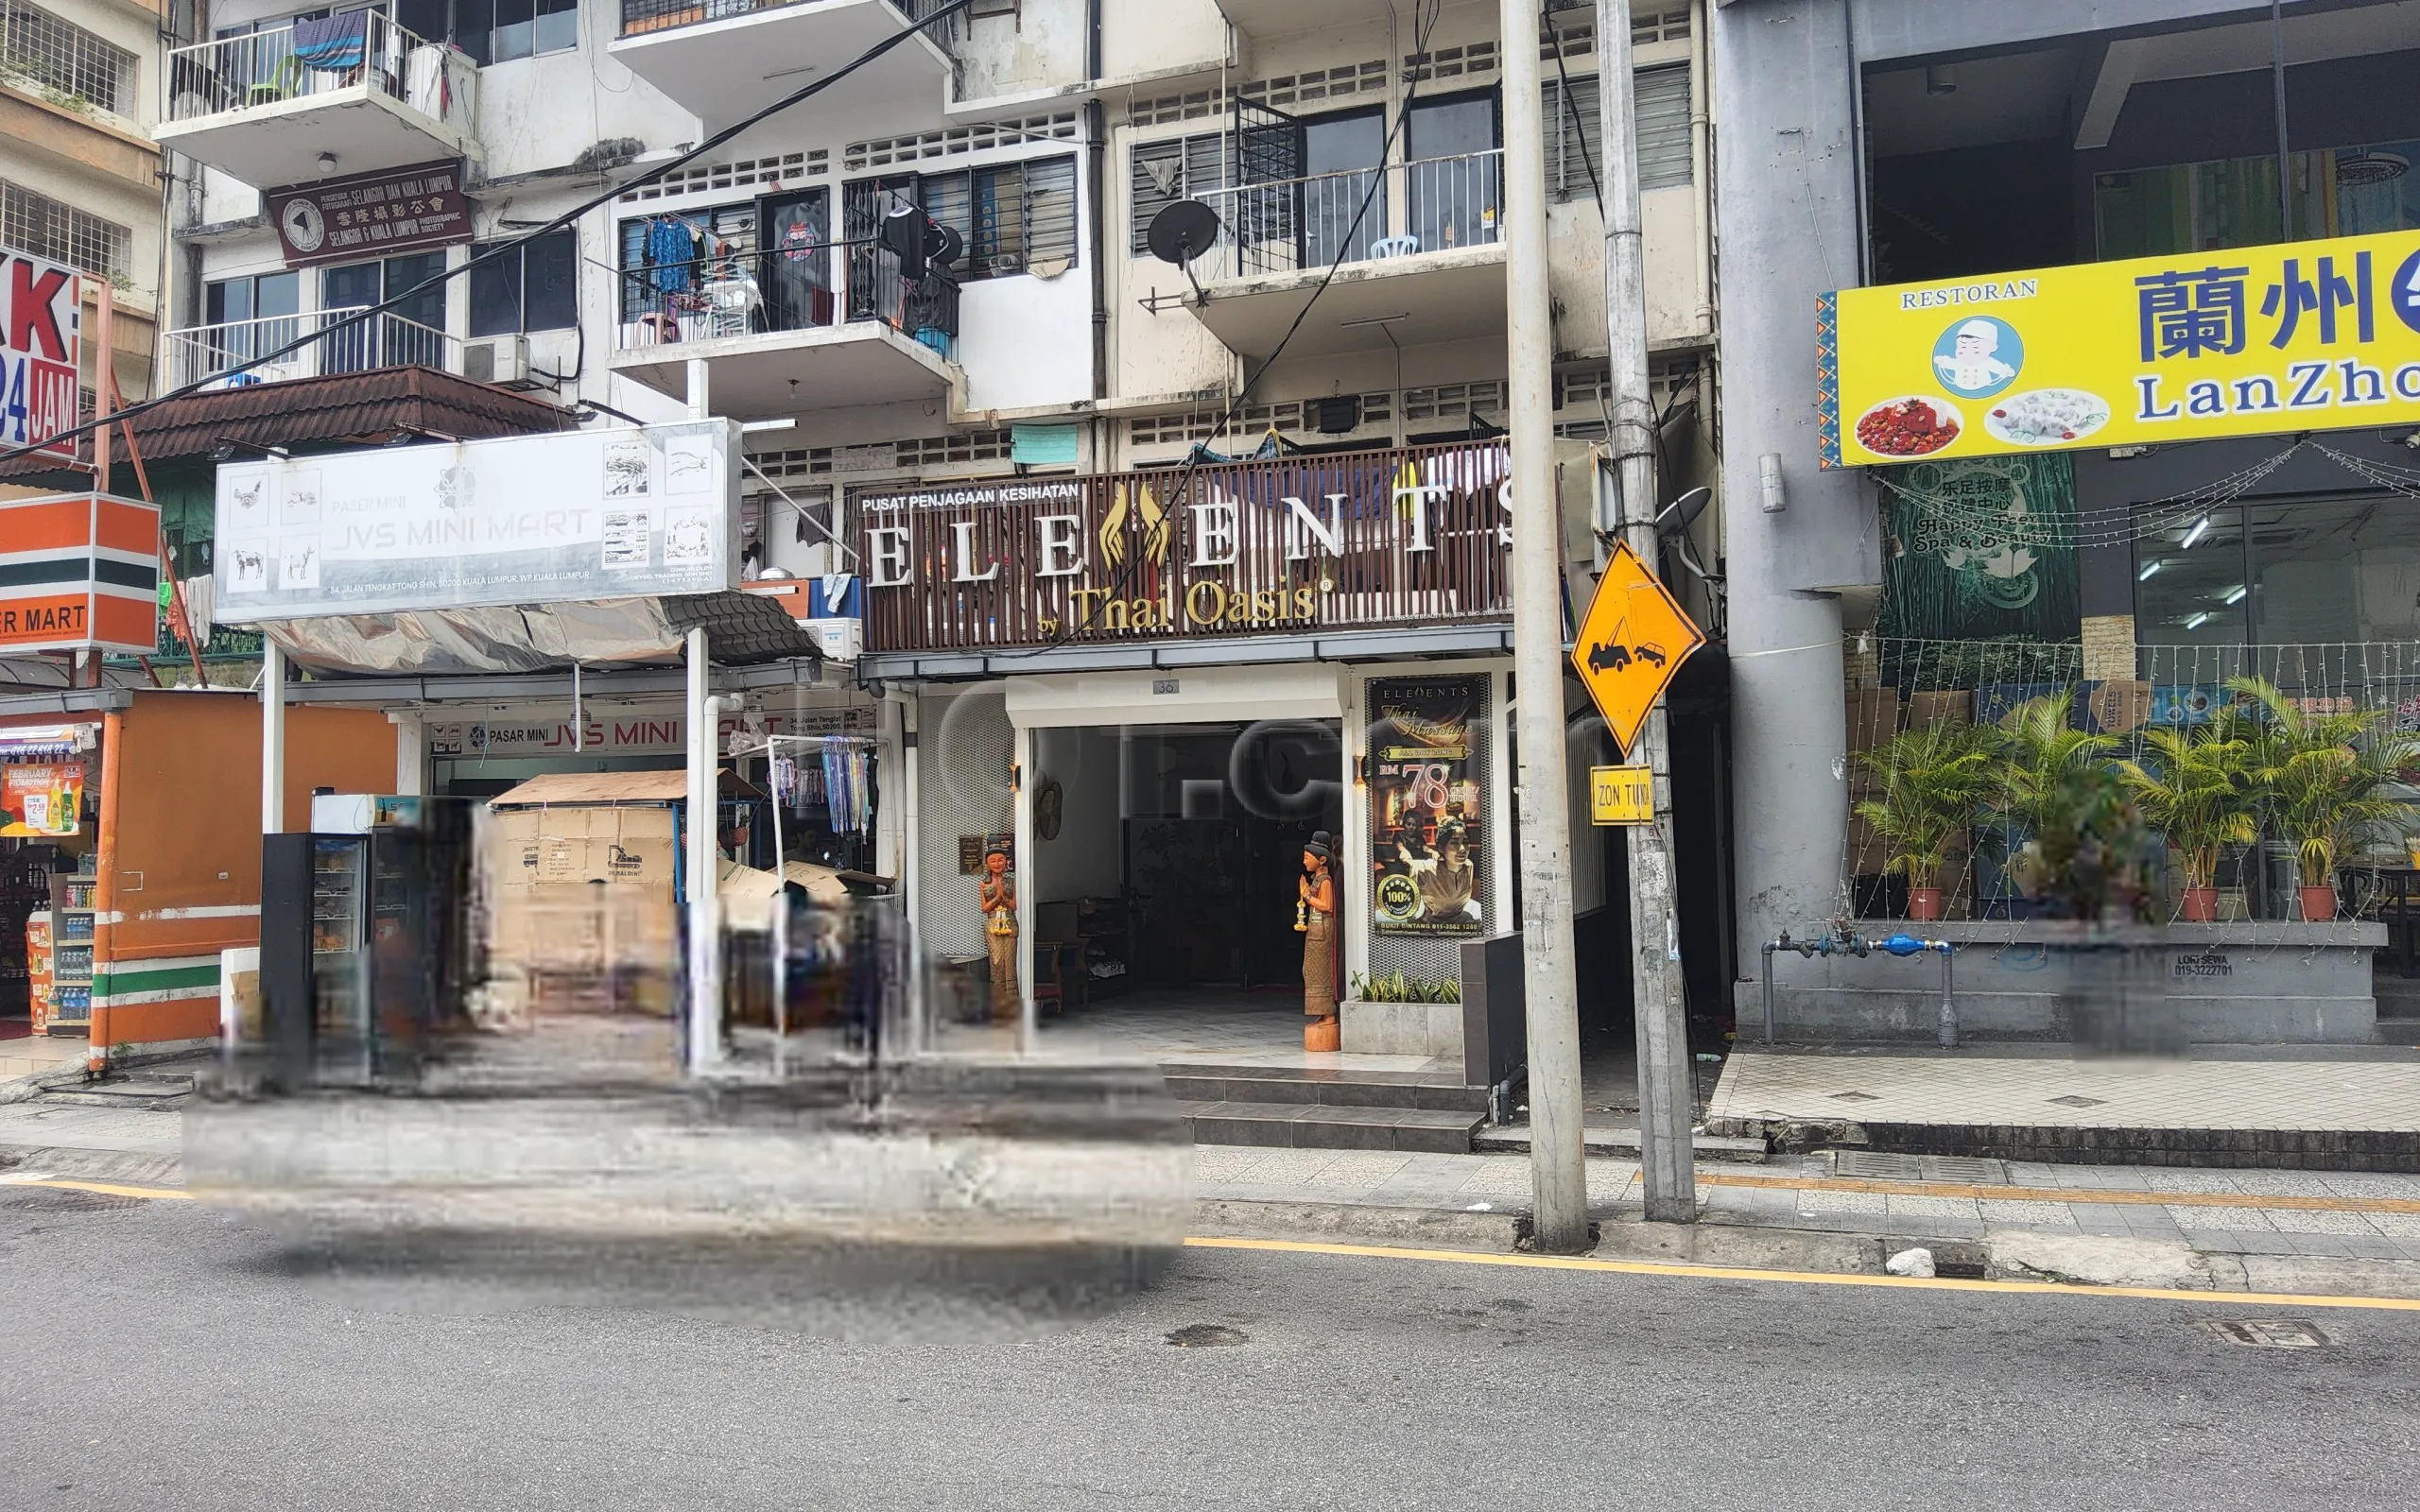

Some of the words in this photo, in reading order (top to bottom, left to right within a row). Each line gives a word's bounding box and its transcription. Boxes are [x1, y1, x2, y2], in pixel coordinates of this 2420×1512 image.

[352, 186, 386, 205] SELANGOR
[386, 183, 402, 200] DAN
[402, 180, 424, 198] KUALA
[425, 175, 453, 194] LUMPUR
[329, 230, 361, 247] SELANGOR
[363, 230, 370, 241] &
[370, 225, 392, 241] KUALA
[394, 219, 419, 237] LUMPUR
[419, 212, 461, 226] PHOTOGRAPHIC
[421, 223, 445, 233] SOCIETY
[1901, 279, 2039, 310] RESTORAN
[0, 253, 71, 363] K
[2135, 250, 2375, 363] 蘭州
[32, 369, 73, 446] JAM
[862, 497, 907, 511] PUSAT
[909, 490, 995, 508] PENJAGAAN
[999, 484, 1080, 502] KESIHATAN
[1942, 477, 2012, 497] 乐足按摩
[376, 495, 406, 510] MINI
[333, 523, 396, 550] JVS
[407, 517, 475, 546] MINI
[488, 508, 592, 541] MART
[1913, 536, 1951, 553] Spa
[1959, 536, 1973, 549] &
[1979, 530, 2052, 549] Beauty
[341, 585, 363, 593] JALAN
[365, 583, 396, 592] TENGKAT
[397, 582, 418, 591] TONG
[438, 578, 461, 587] 50200
[462, 577, 486, 586] KUALA
[559, 571, 590, 580] LUMPUR
[1037, 616, 1063, 637] by
[1070, 583, 1171, 632] Thai
[1185, 575, 1316, 627] Oasis
[0, 610, 16, 633] R
[26, 606, 85, 631] MART
[1159, 680, 1174, 694] 36
[1381, 703, 1419, 720] Thai
[2107, 691, 2117, 729] TOWELS
[490, 730, 524, 743] PASAR
[527, 729, 548, 742] MINI
[544, 724, 604, 747] JVS
[615, 721, 678, 745] MINI
[790, 725, 805, 733] Tong
[1405, 719, 1473, 743] Massage
[9, 768, 53, 778] FEBRUARY
[9, 778, 50, 788] PROMOTION
[1379, 765, 1399, 775] RM
[1402, 764, 1449, 808] 78
[1599, 784, 1620, 807] ZON
[1387, 891, 1410, 902] 100%
[2175, 965, 2233, 976] 019-3222701
[2201, 954, 2228, 965] SEWA
